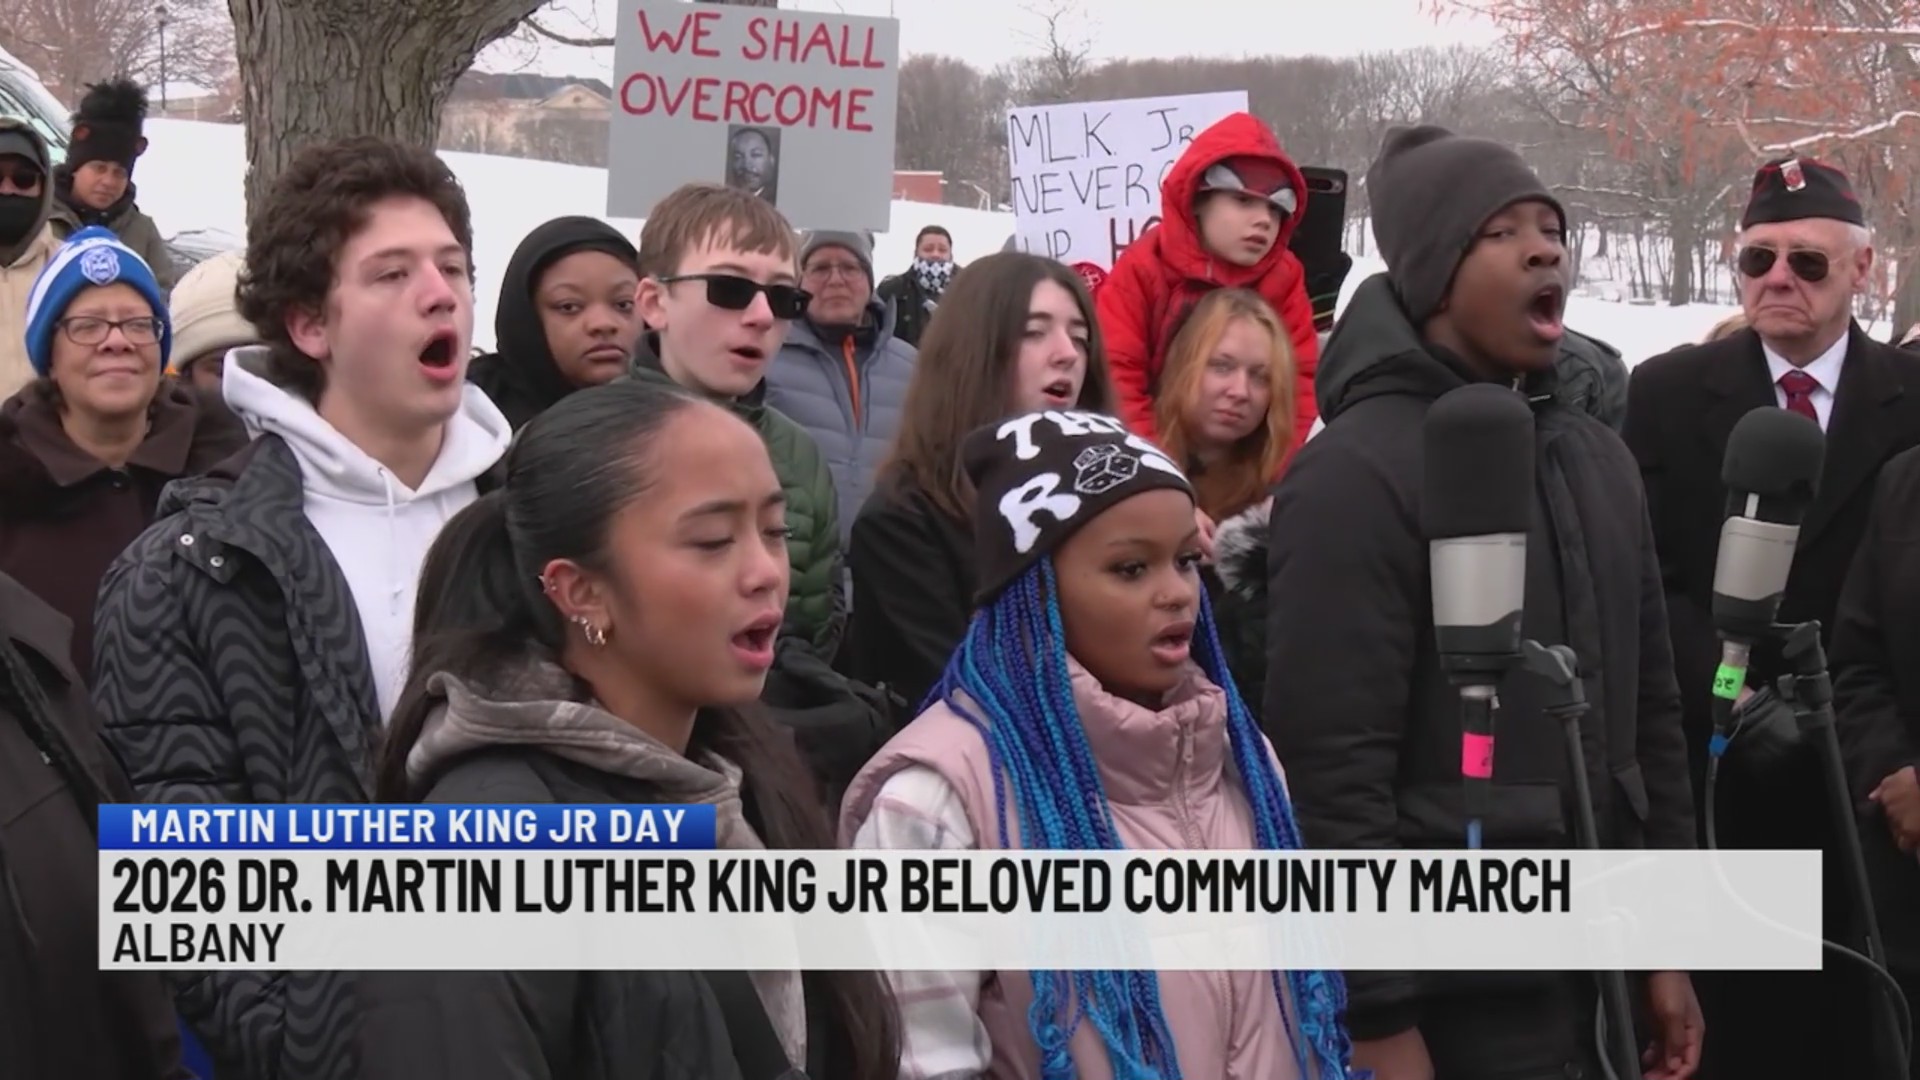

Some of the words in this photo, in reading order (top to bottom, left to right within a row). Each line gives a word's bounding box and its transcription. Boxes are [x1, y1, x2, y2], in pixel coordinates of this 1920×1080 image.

[638, 9, 722, 58] WE
[741, 17, 885, 69] SHALL
[620, 72, 874, 132] OVERCOME
[1011, 163, 1150, 217] NEVER
